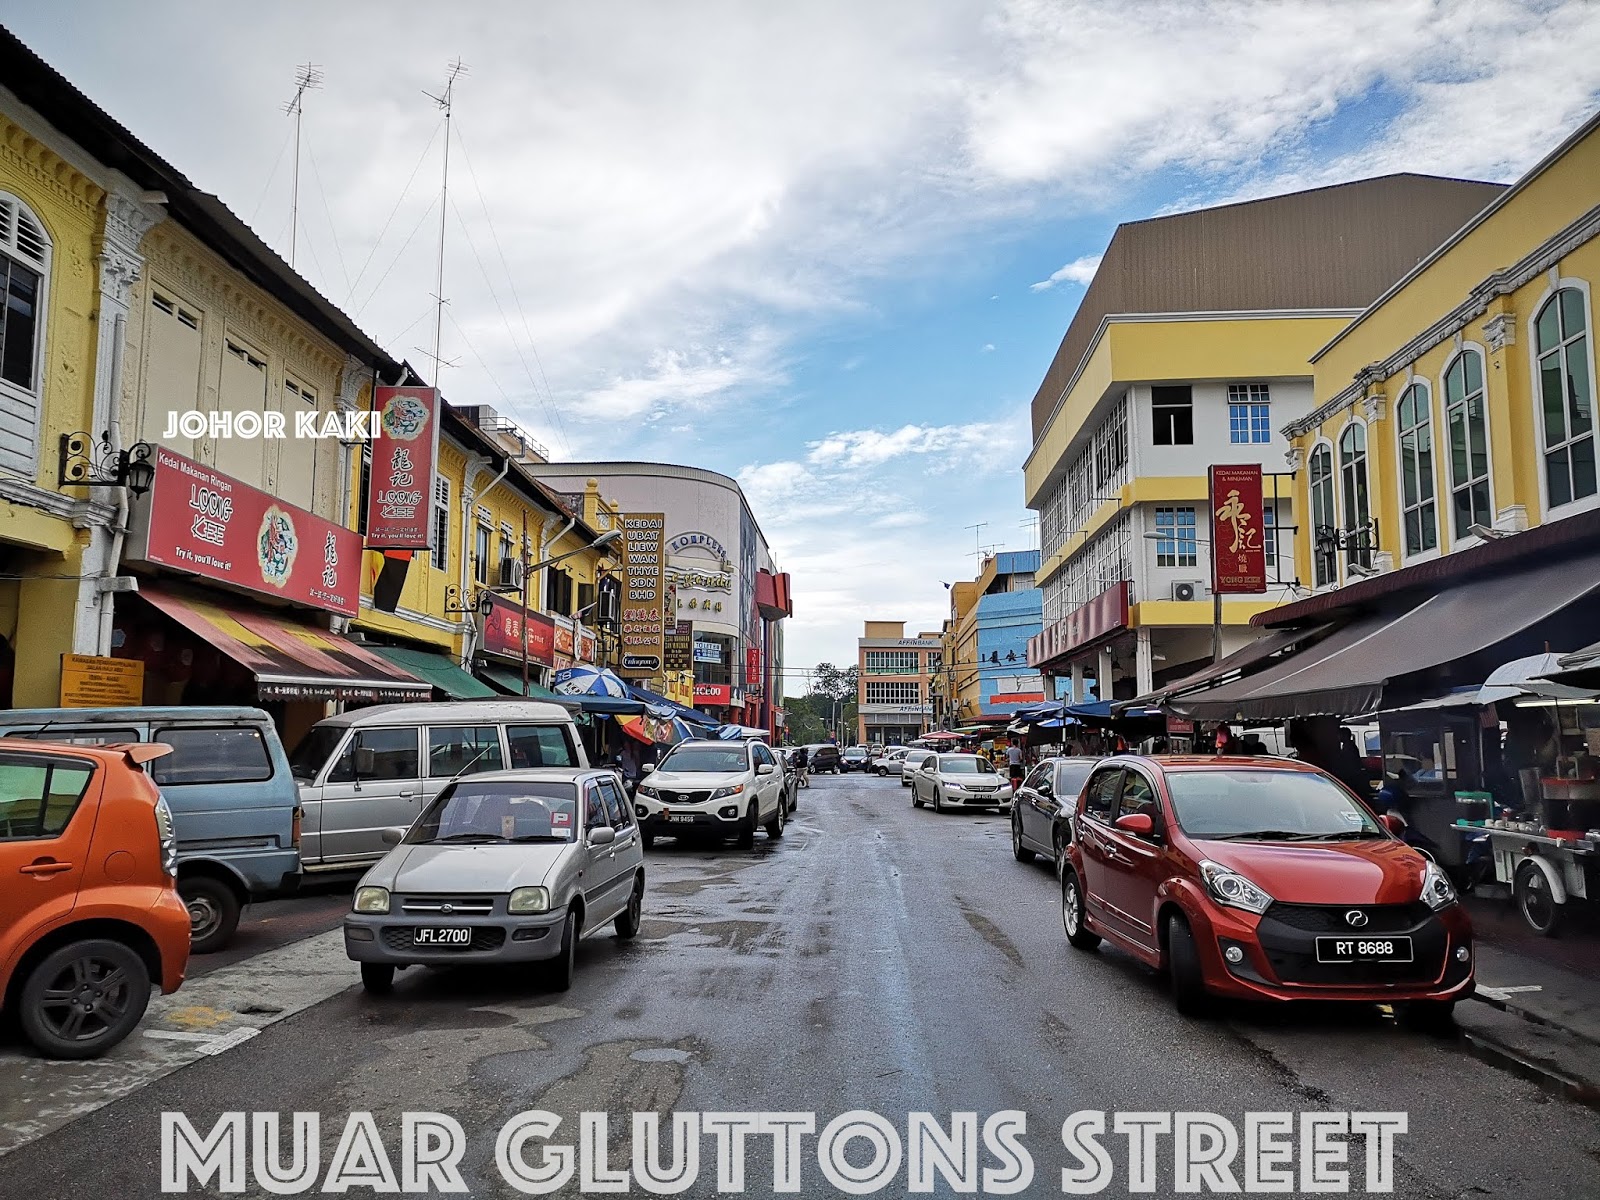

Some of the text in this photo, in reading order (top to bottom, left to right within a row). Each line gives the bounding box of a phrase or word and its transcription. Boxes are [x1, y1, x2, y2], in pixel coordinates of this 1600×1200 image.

[159, 452, 232, 492] Kedai Makanan Ringan
[189, 484, 233, 522] LOONG
[377, 489, 422, 505] LOONG
[380, 505, 416, 518] KEE
[191, 514, 226, 547] KEE
[625, 519, 663, 529] KEDAI
[627, 531, 659, 541] UBAT
[628, 542, 658, 552] LIEW
[671, 535, 727, 559] KOMPLEKS
[176, 547, 186, 559] Try
[194, 553, 211, 565] you'll
[211, 556, 224, 569] love
[628, 554, 658, 564] WAN
[627, 566, 659, 576] THYE
[629, 578, 656, 588] SDN
[629, 590, 656, 600] BHD
[553, 812, 568, 824] P
[415, 928, 468, 942] JFL2700
[1336, 941, 1394, 954] RT 8688
